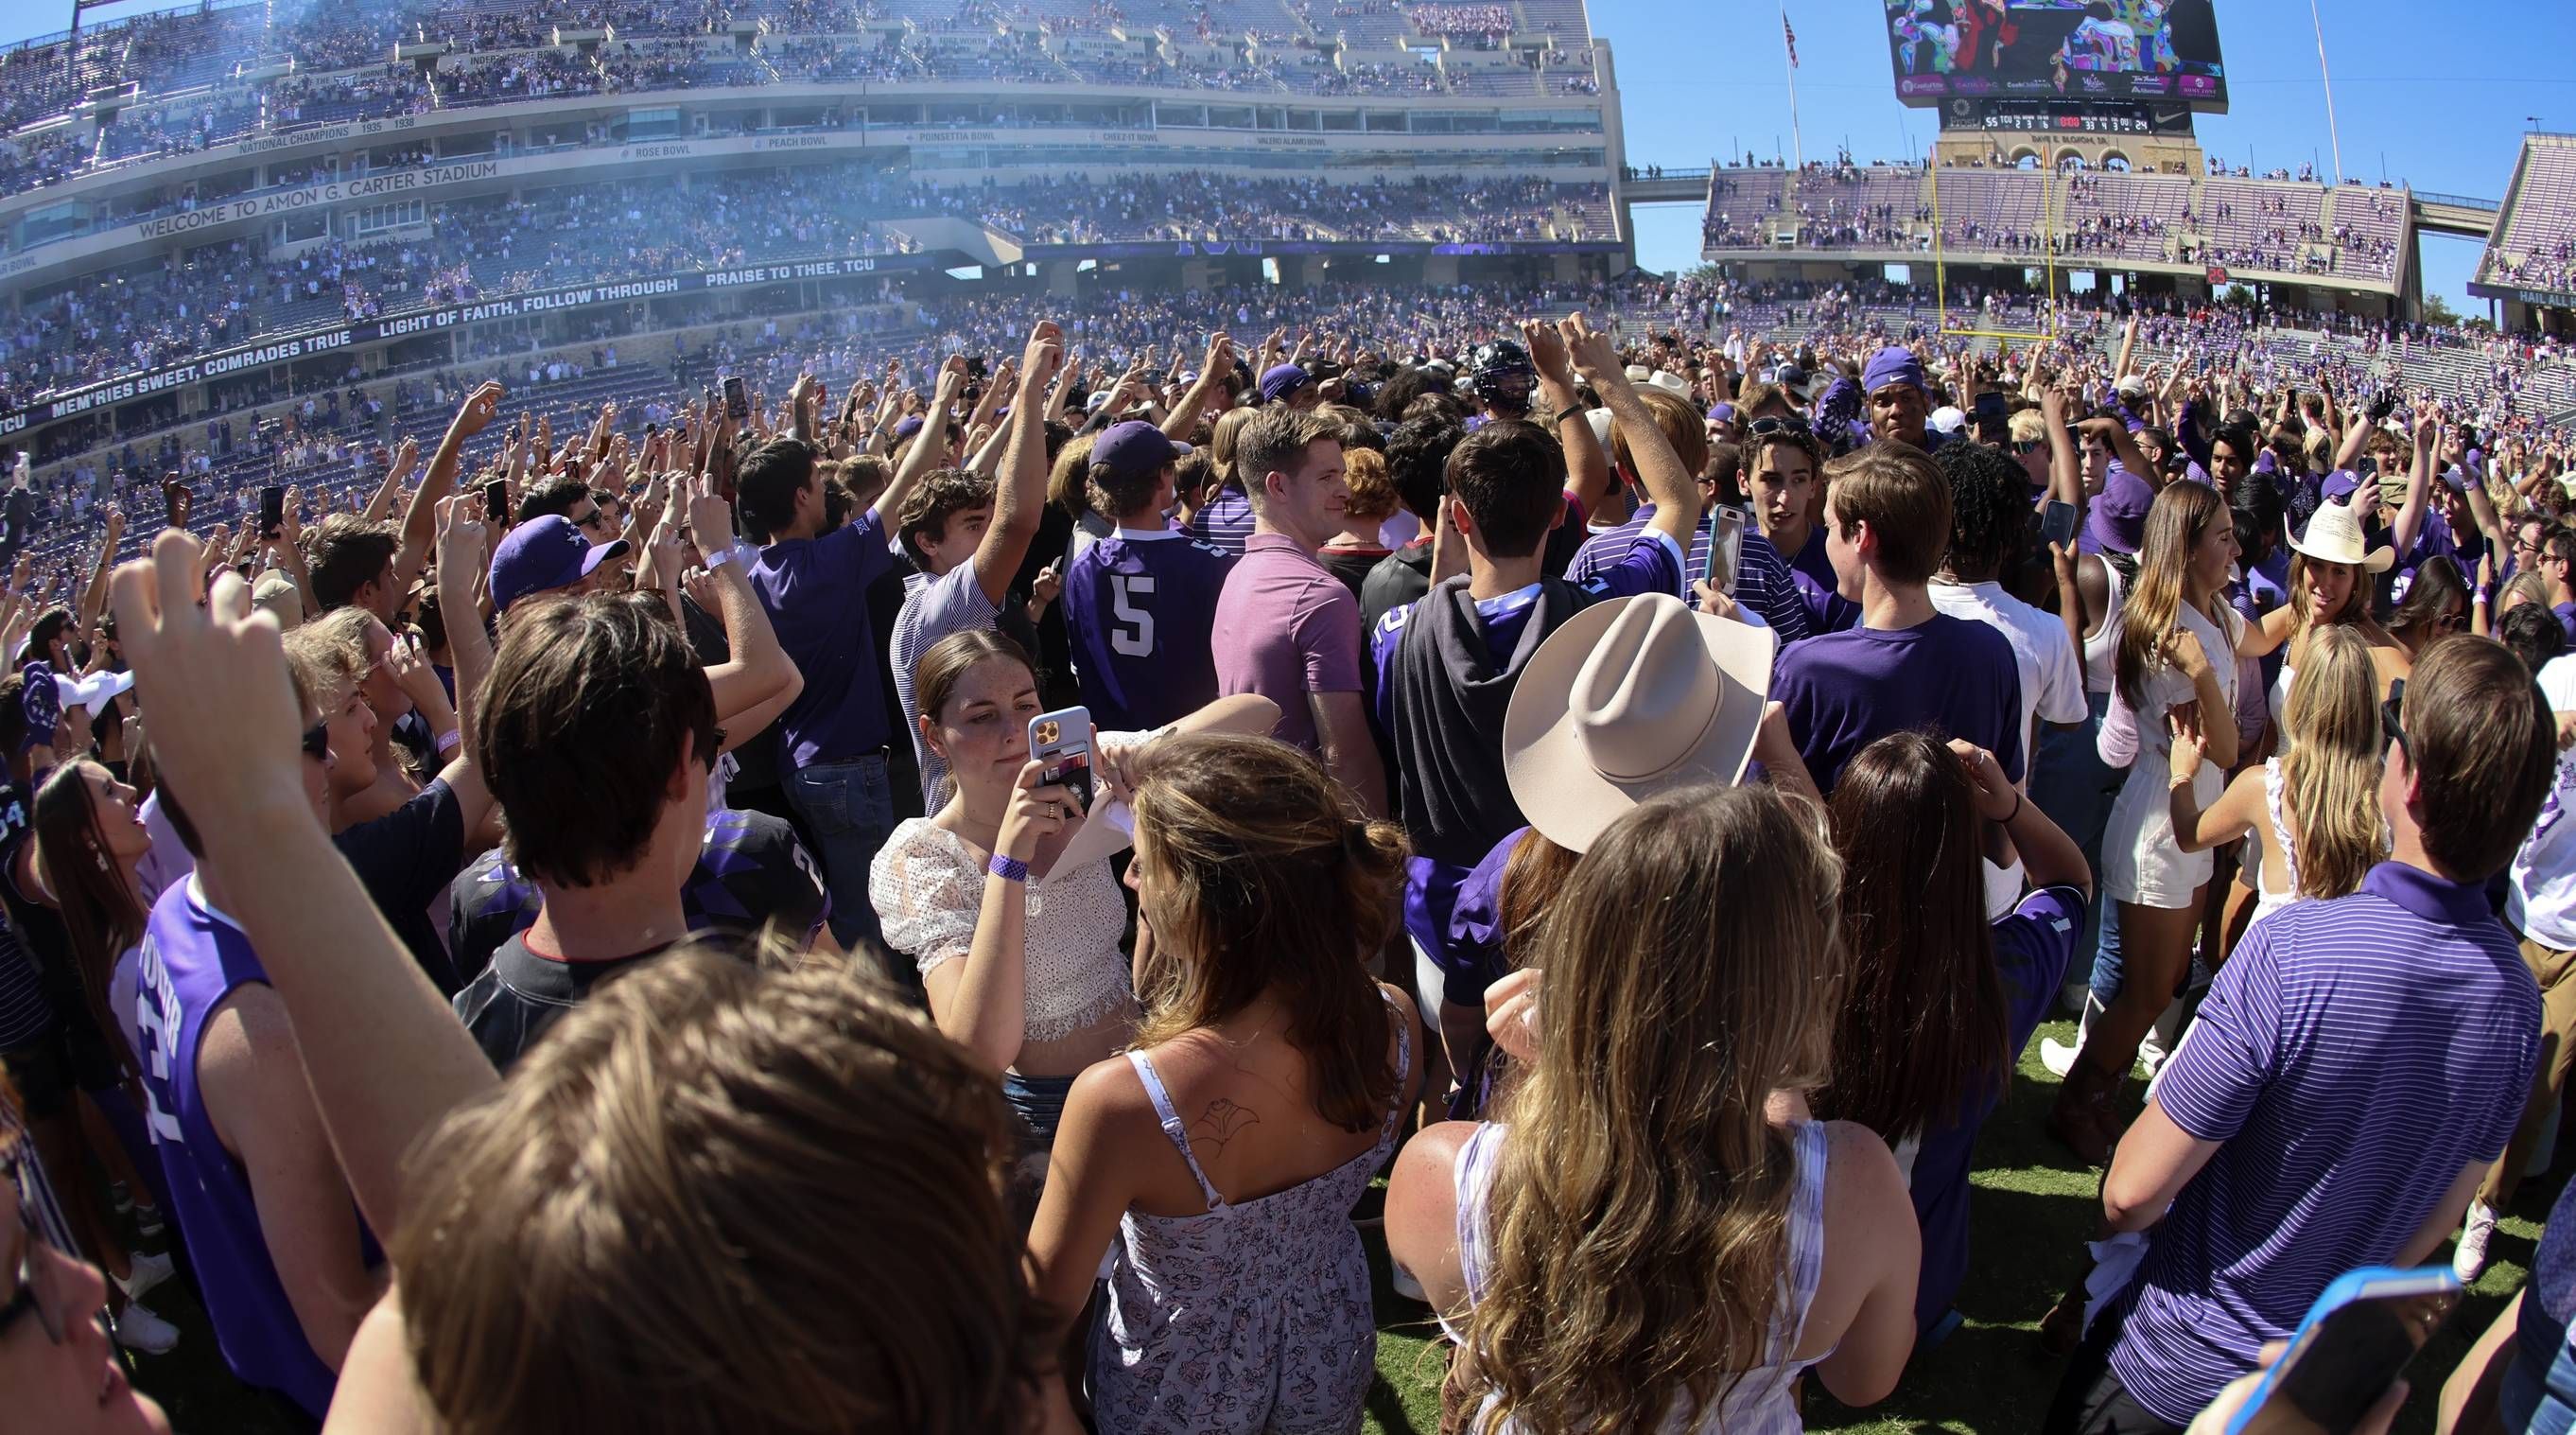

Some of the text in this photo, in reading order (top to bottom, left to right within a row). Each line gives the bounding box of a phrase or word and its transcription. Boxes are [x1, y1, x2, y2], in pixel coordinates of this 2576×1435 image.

[239, 117, 414, 154] NATIONAL CHAMPIONS 1935 1938
[2000, 114, 2012, 124] TCU
[2027, 120, 2032, 129] 3
[2086, 121, 2095, 131] 33
[2101, 122, 2107, 131] 4
[2135, 120, 2148, 130] 24
[635, 145, 691, 158] ROSE BOWL
[769, 136, 827, 148] PEACH BOWL
[139, 162, 497, 237] WELCOME TO AMON G. CARTER STADIUM
[2519, 290, 2547, 305] HAIL
[2549, 293, 2568, 307] ALL
[52, 382, 134, 418] MEM'RIES
[138, 365, 200, 394] SWEET,
[204, 341, 301, 376] COMRADES
[305, 330, 351, 353] TRUE
[379, 315, 431, 338] LIGHT
[436, 309, 458, 326] OF
[462, 301, 518, 323] FAITH,
[523, 289, 593, 312] FOLLOW
[597, 278, 679, 301] THROUGH
[705, 269, 766, 287] PRAISE
[769, 266, 791, 280] TO
[794, 262, 841, 276] THEE,
[844, 258, 876, 272] TCU
[1109, 574, 1155, 658] 5
